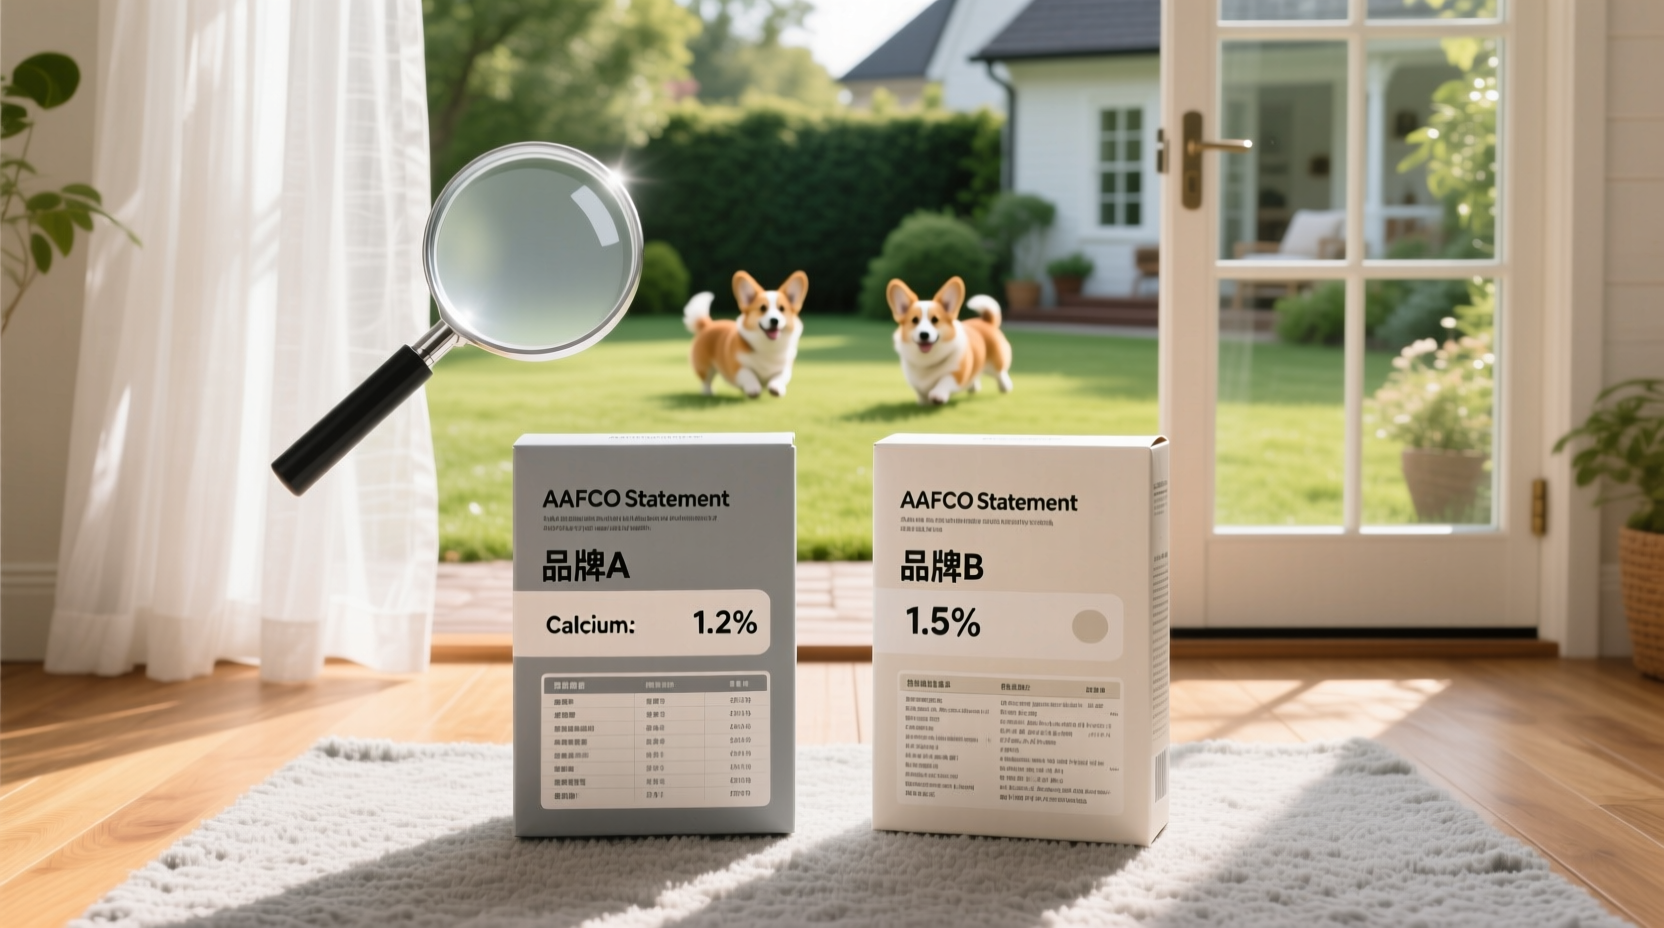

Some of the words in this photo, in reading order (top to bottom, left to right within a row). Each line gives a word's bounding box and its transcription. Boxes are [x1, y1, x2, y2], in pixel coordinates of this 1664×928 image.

[542, 488, 621, 508] AAFCO
[624, 489, 730, 508] Statement
[900, 490, 974, 510] AAFCO
[977, 492, 1078, 512] Statement
[542, 549, 631, 583] 品牌A
[900, 549, 984, 584] 品牌B
[546, 614, 635, 635] Calcium:
[693, 609, 758, 635] 1.2%
[906, 606, 981, 638] 1.5%
